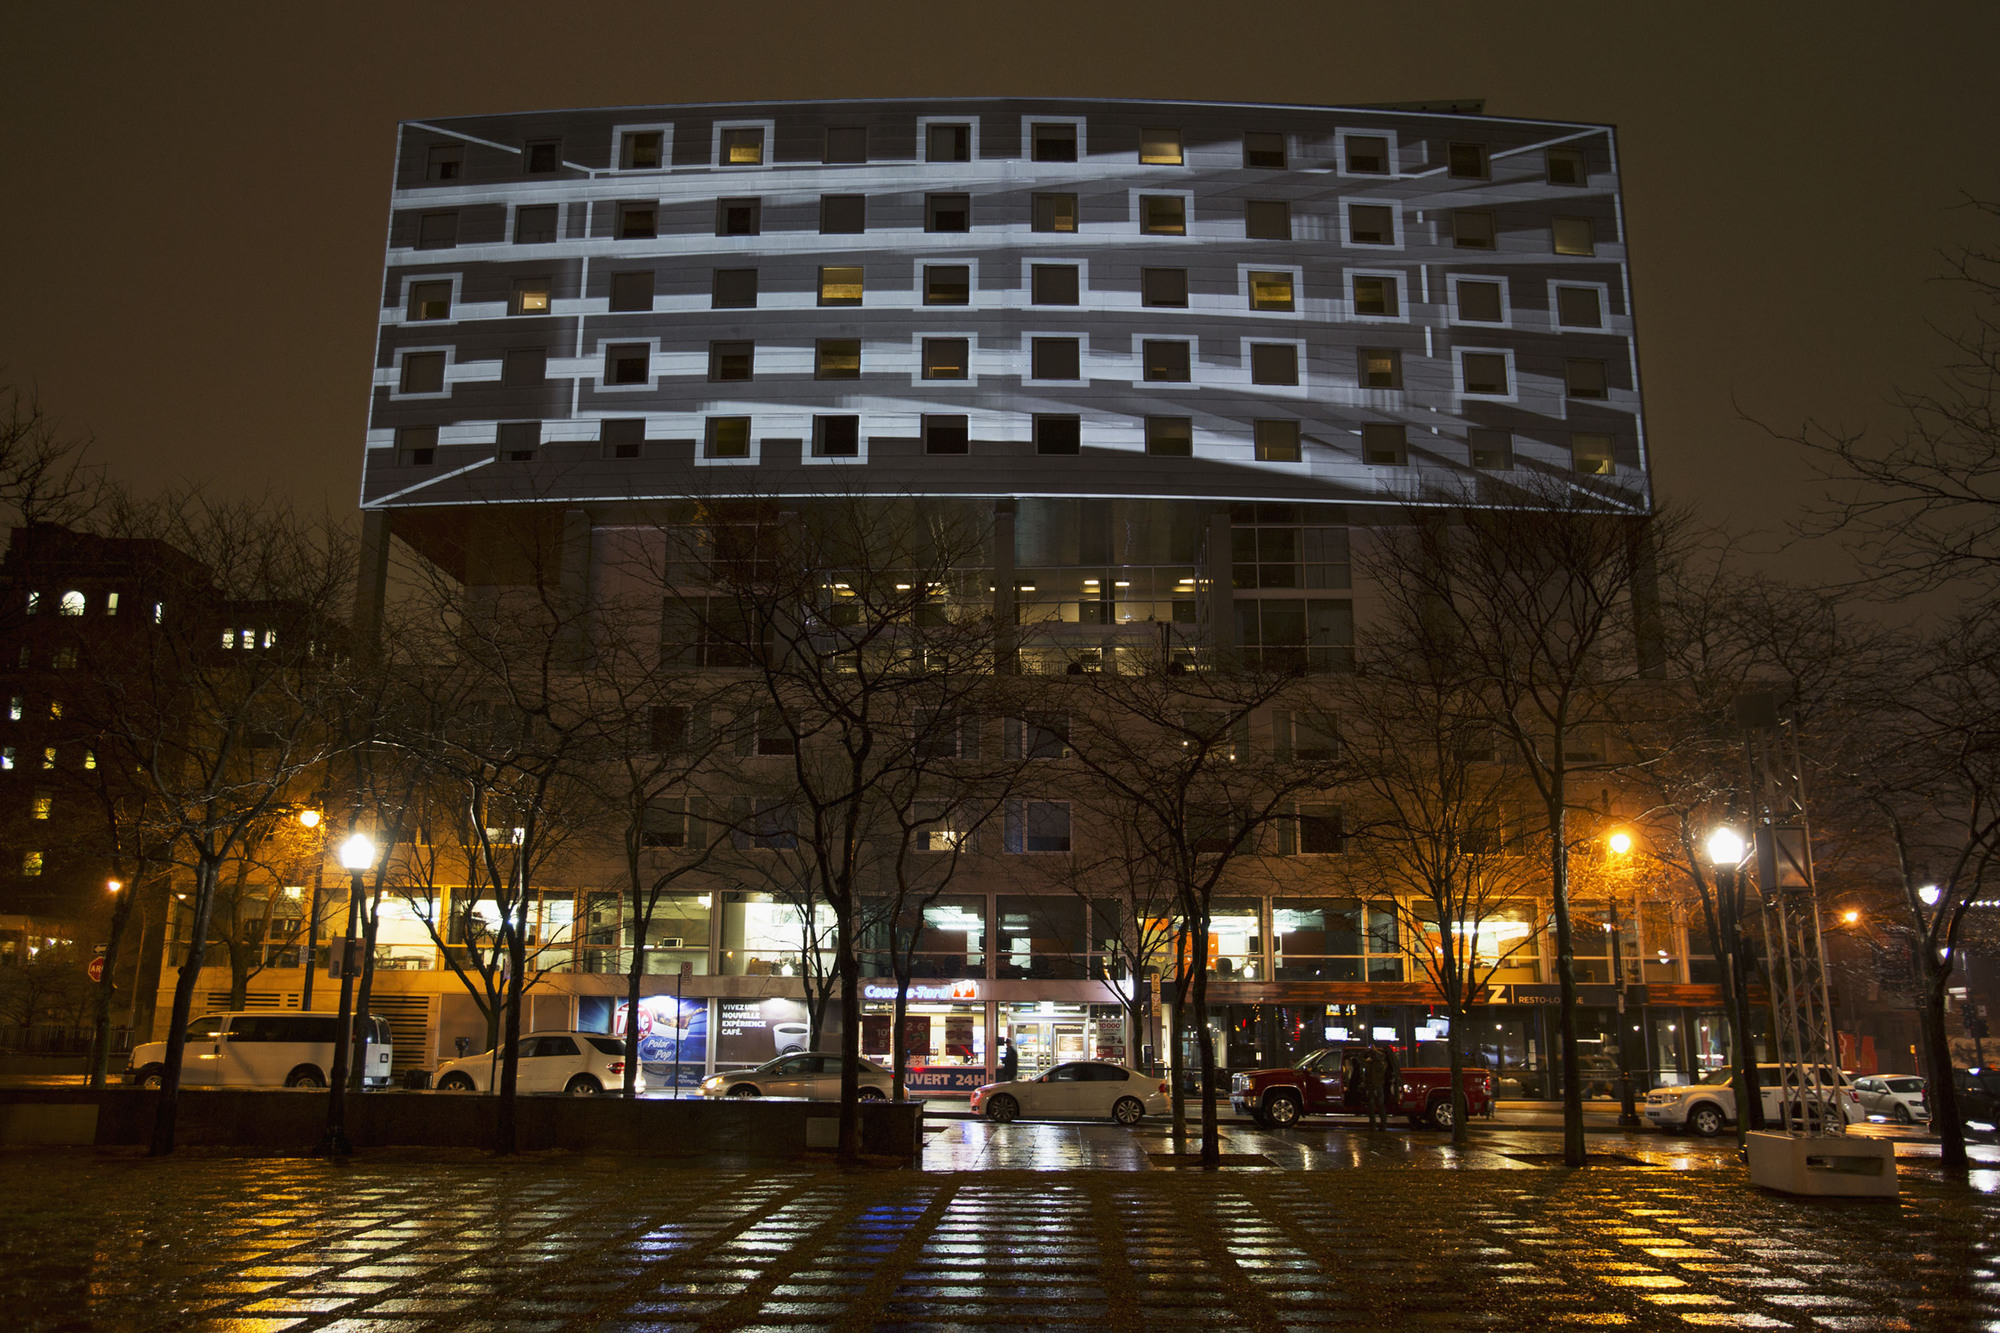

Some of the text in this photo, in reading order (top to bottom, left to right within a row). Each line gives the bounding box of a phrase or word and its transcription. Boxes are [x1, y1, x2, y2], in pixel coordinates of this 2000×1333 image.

[864, 985, 949, 999] Couce-Tard
[1488, 985, 1584, 1004] Z RESTO-LOE
[722, 1019, 767, 1027] EXPÉRIENCE
[647, 1039, 670, 1049] Polar
[654, 1049, 672, 1060] Pop
[904, 1073, 985, 1086] UVERT 24H
